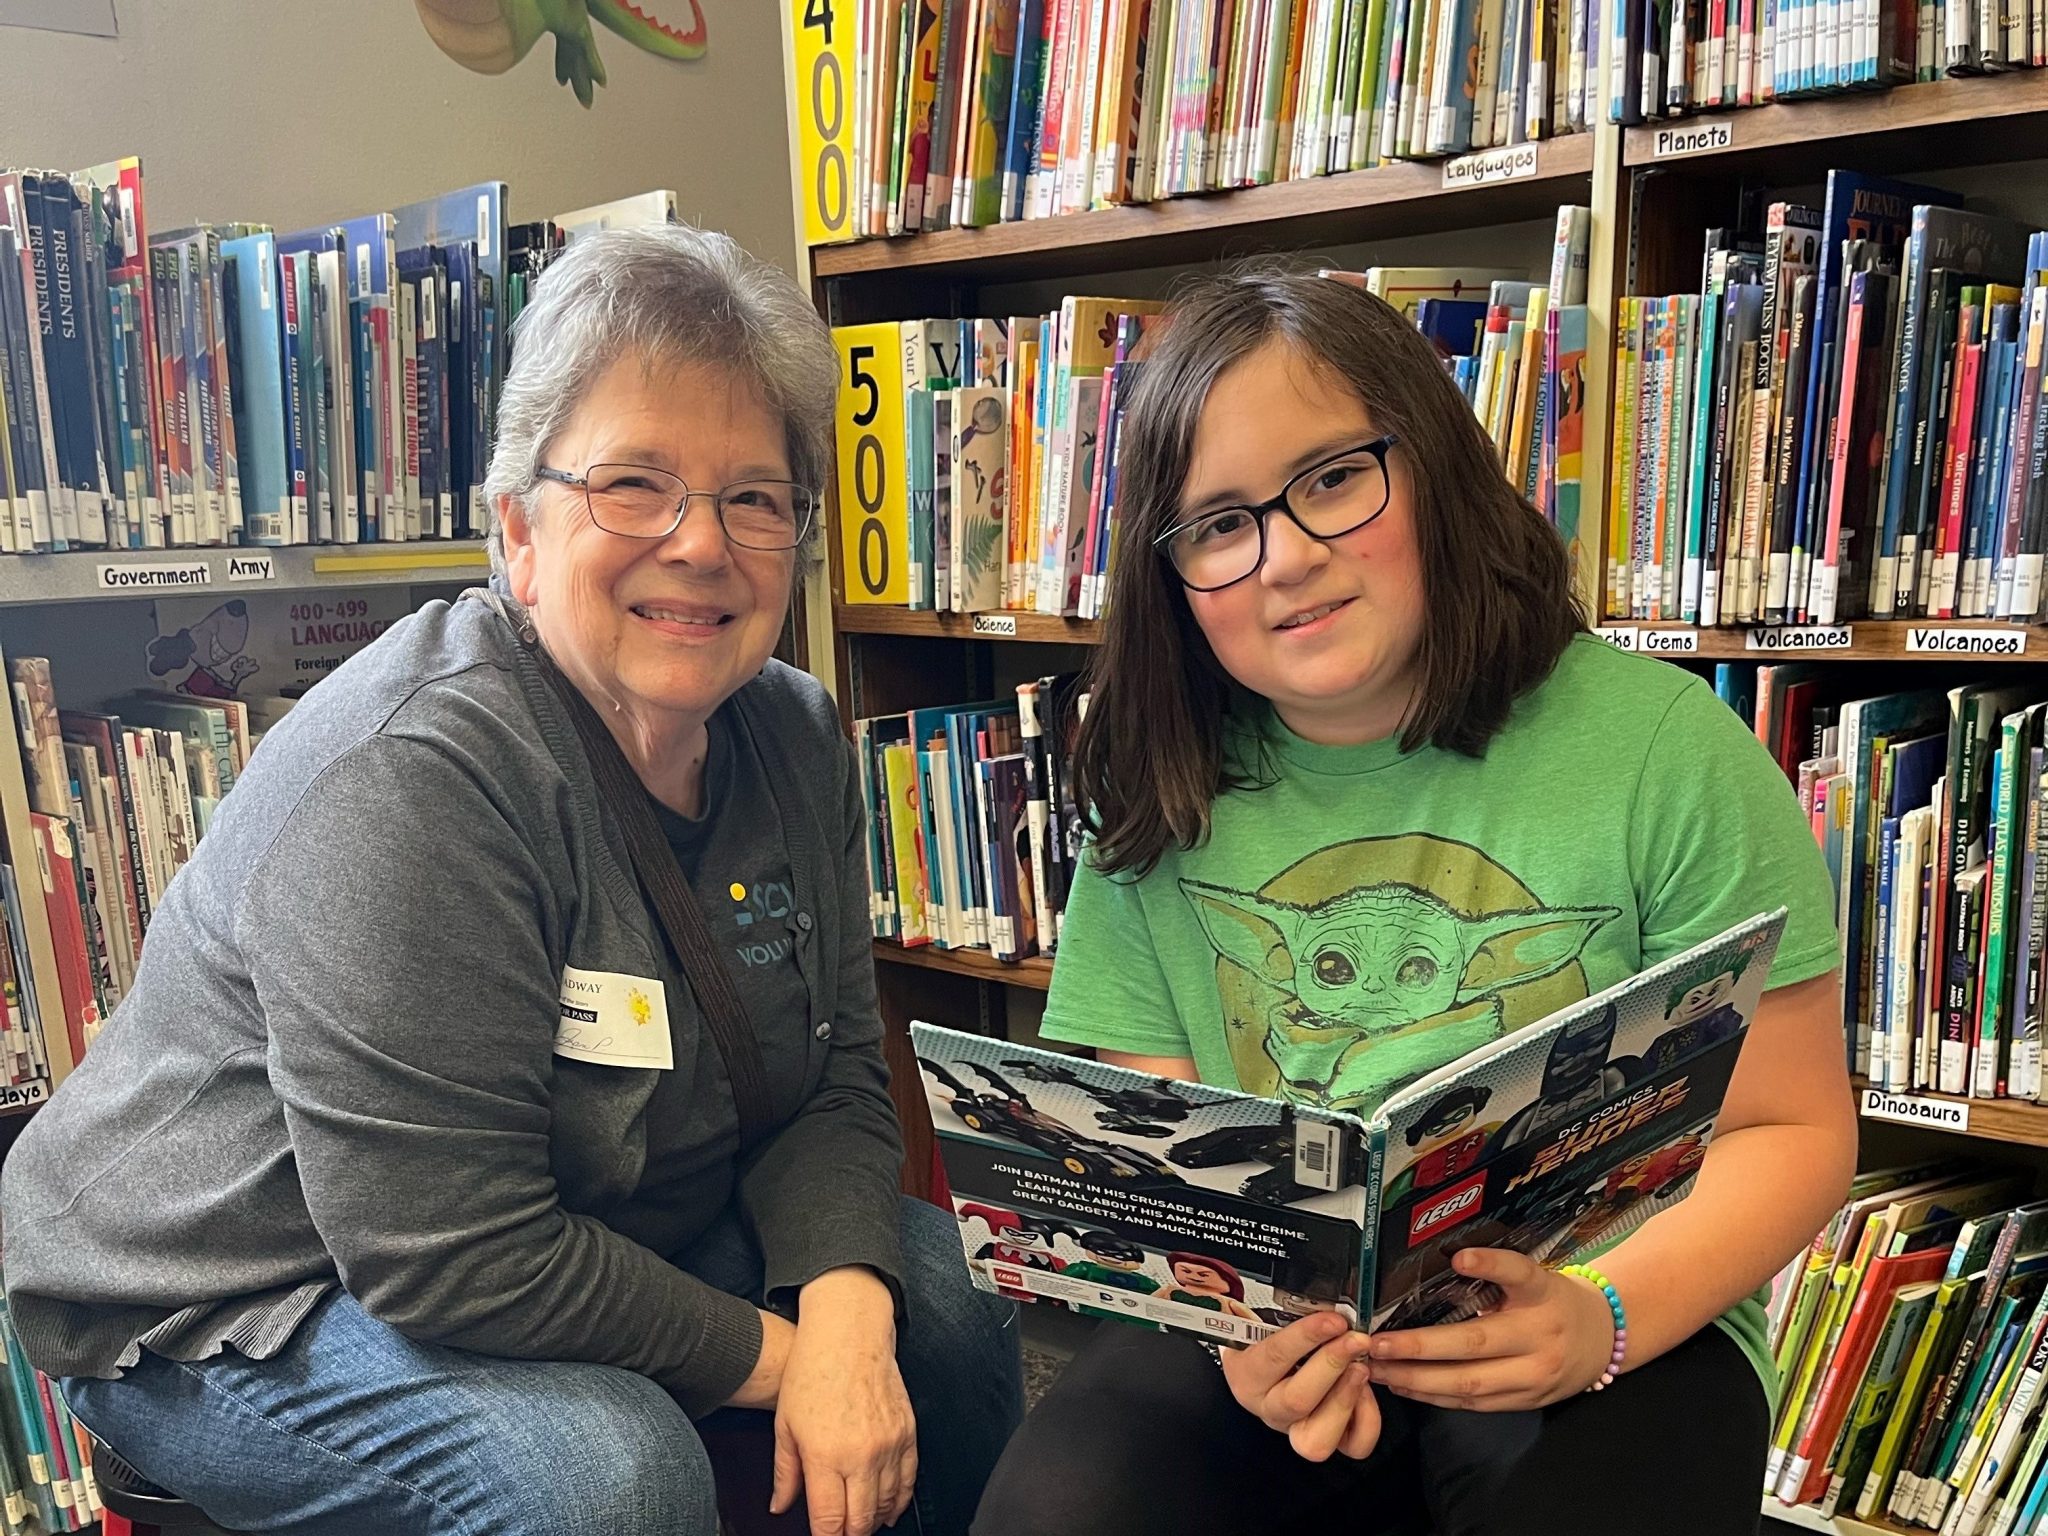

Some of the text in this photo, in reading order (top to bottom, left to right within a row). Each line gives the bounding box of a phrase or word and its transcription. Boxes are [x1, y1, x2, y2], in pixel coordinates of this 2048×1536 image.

[1029, 94, 1046, 175] DICTIONARY
[1659, 130, 1727, 153] Planets
[1447, 152, 1534, 182] Languages
[189, 245, 199, 273] EPIC
[209, 237, 218, 265] EPIC
[155, 252, 165, 279] EPIC
[169, 252, 178, 280] EPIC
[29, 225, 52, 335] PRESIDENTS
[53, 228, 76, 339] PRESIDENTS
[1756, 234, 1781, 385] EYEWITNESS BOOKS
[905, 333, 919, 375] Your
[1644, 361, 1652, 383] ROCK
[178, 391, 188, 444] PATROLLING
[318, 392, 326, 423] SPECIAL
[406, 358, 418, 478] DETECTIVE DICTIONARY
[1641, 394, 1650, 421] FOSSIL
[1717, 407, 1726, 431] HOTTEST
[294, 415, 302, 450] CHARLIE
[1530, 391, 1547, 459] COUNTING
[1624, 411, 1632, 439] WHAT
[1659, 394, 1672, 464] SEDIMENTARY
[1750, 397, 1764, 455] VOLCANO
[1716, 432, 1724, 451] PLACE
[1779, 416, 1795, 485] Into the Volcano
[1913, 420, 1926, 466] Volcanoes
[2032, 404, 2048, 479] Tracking Trash
[1526, 464, 1539, 498] BOOK
[1638, 459, 1646, 480] HOW
[1657, 466, 1667, 500] ROCKS
[1950, 451, 1967, 516] Volcanoes
[1060, 471, 1069, 506] NATURE
[1621, 464, 1629, 512] MINERAL?
[1711, 480, 1720, 499] EARTH
[1058, 507, 1066, 535] BOOK
[1710, 500, 1719, 523] SCIENCE
[1742, 468, 1761, 551] EARTHQUAKE
[1634, 517, 1644, 541] ROCK
[1709, 525, 1718, 553] RECORDS
[104, 566, 207, 585] Government
[230, 558, 269, 578] Army
[290, 600, 368, 621] 400-499
[974, 618, 1014, 633] Science
[1605, 630, 1631, 648] cks
[1755, 629, 1850, 648] Volcanoes
[1646, 631, 1692, 650] Gems
[1915, 630, 2019, 653] Volcanoes
[295, 656, 339, 672] Foreign
[1965, 721, 1975, 755] Wonders
[1959, 769, 1971, 803] Learning
[127, 814, 136, 830] How
[2027, 800, 2039, 854] DICTIONARY
[129, 831, 138, 842] the
[131, 843, 141, 869] Ostrich
[1989, 770, 2012, 937] WORLD ATLAS OF DINOSAURS
[136, 870, 144, 883] Got
[138, 885, 146, 894] Its
[138, 895, 149, 912] Long
[1956, 894, 1968, 951] BACKPACK BOOKS
[1876, 918, 1887, 957] DINOSAURS
[1876, 958, 1885, 975] LIVE
[1875, 984, 1883, 1003] YOUR
[1949, 984, 1958, 1008] ABOUT
[1956, 986, 1964, 1007] FACTS
[572, 1008, 594, 1021] PASS
[1533, 1075, 1690, 1164] SUPER
[1558, 1084, 1654, 1140] DC COMICS
[1868, 1092, 1961, 1124] Dinosaurs
[1504, 1087, 1692, 1194] HEROES
[992, 1163, 1022, 1177] JOIN
[1086, 1183, 1101, 1193] IN
[1104, 1188, 1126, 1199] HIS
[1129, 1194, 1194, 1215] CRUSADE
[1197, 1209, 1257, 1229] AGAINST
[1260, 1224, 1310, 1242] CRIME.
[1016, 1179, 1061, 1197] LEARN
[1064, 1190, 1090, 1202] ALL
[1092, 1197, 1138, 1213] ABOUT
[1141, 1208, 1163, 1219] HIS
[1166, 1213, 1229, 1234] AMAZING
[1412, 1184, 1483, 1234] LEGO
[1012, 1189, 1291, 1260] GREAT GADGETS, AND MUCH, MUCH MORE.
[997, 1270, 1020, 1283] LEGO
